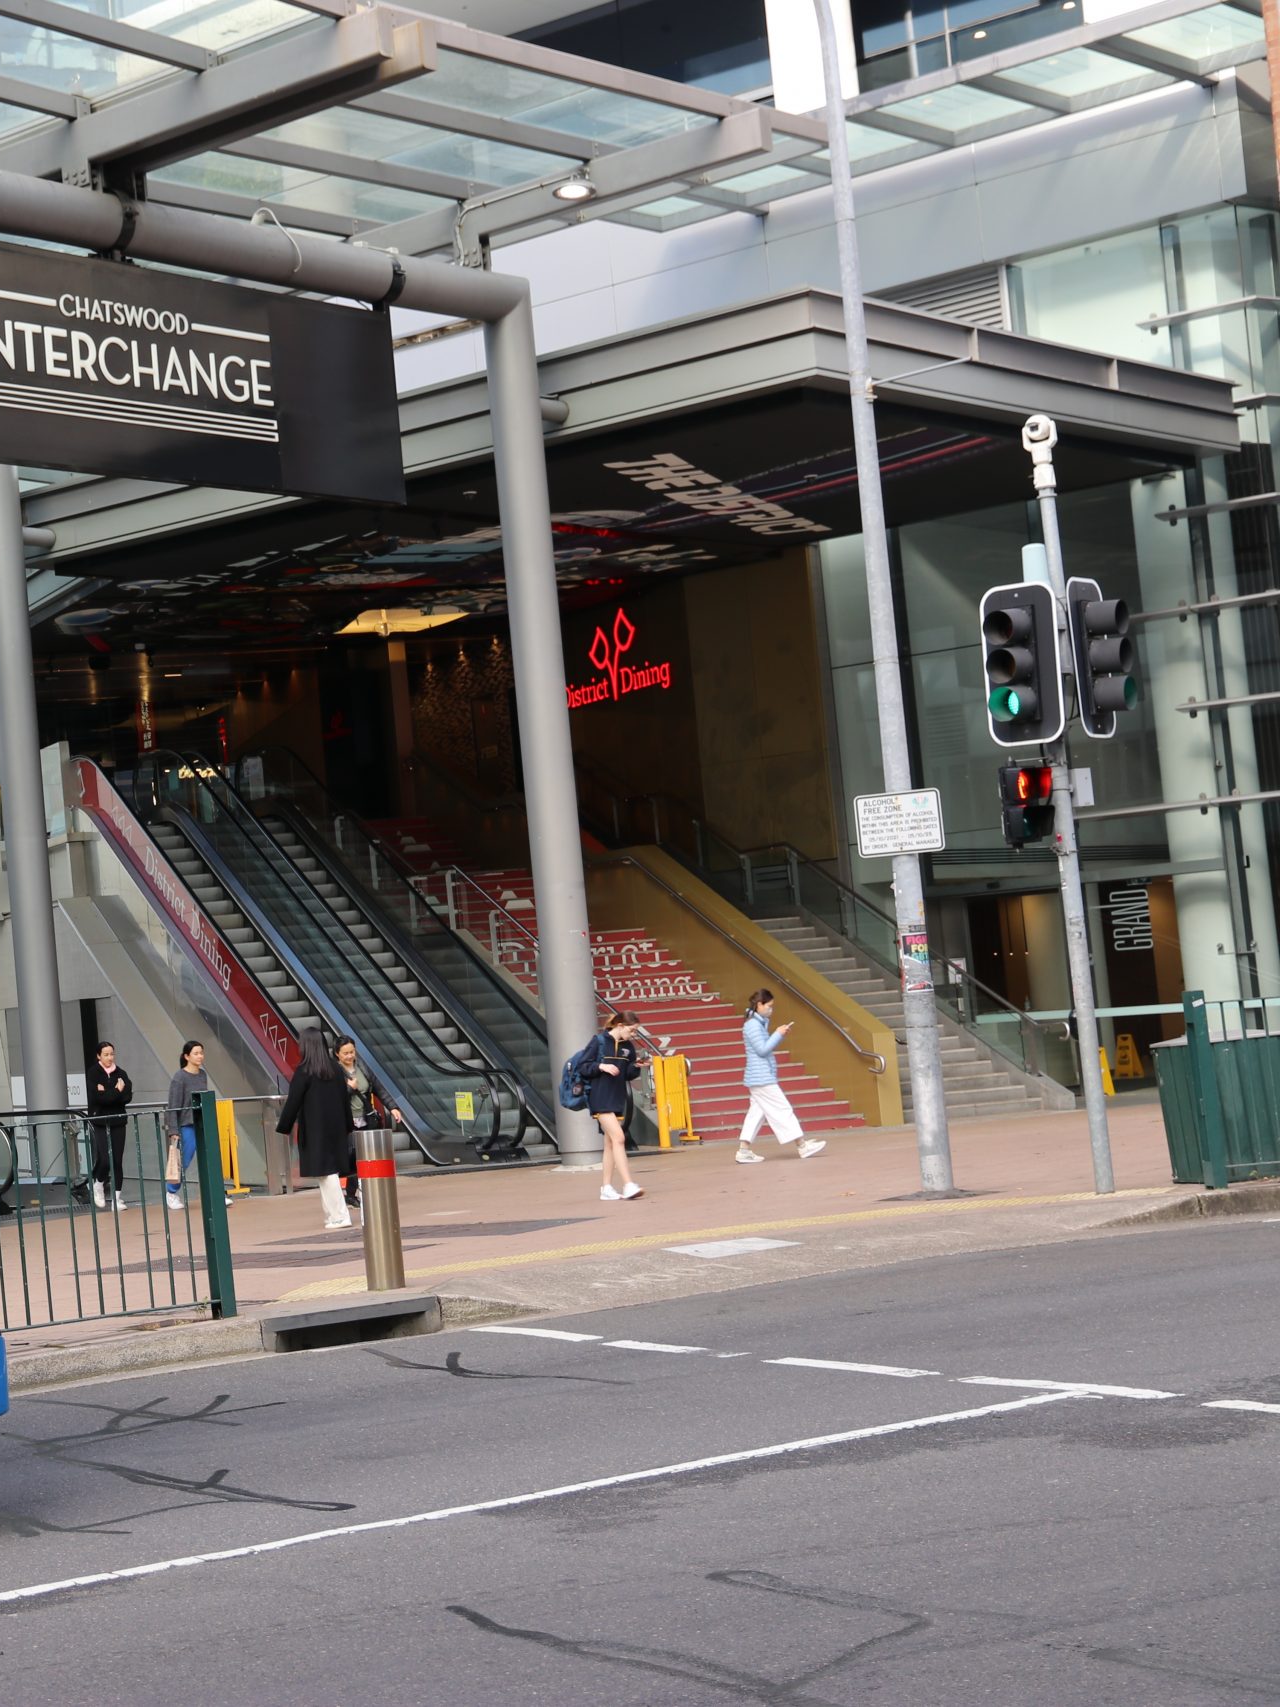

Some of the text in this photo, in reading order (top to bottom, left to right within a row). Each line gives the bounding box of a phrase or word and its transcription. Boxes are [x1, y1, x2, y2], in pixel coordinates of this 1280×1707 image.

[59, 294, 189, 335] CHATSWOOD
[620, 661, 670, 693] Dining
[863, 798, 895, 807] ALCOHOL
[863, 807, 880, 815] FREE
[145, 846, 232, 991] District Dining
[1109, 889, 1154, 951] GRAND
[906, 935, 928, 945] FIGH
